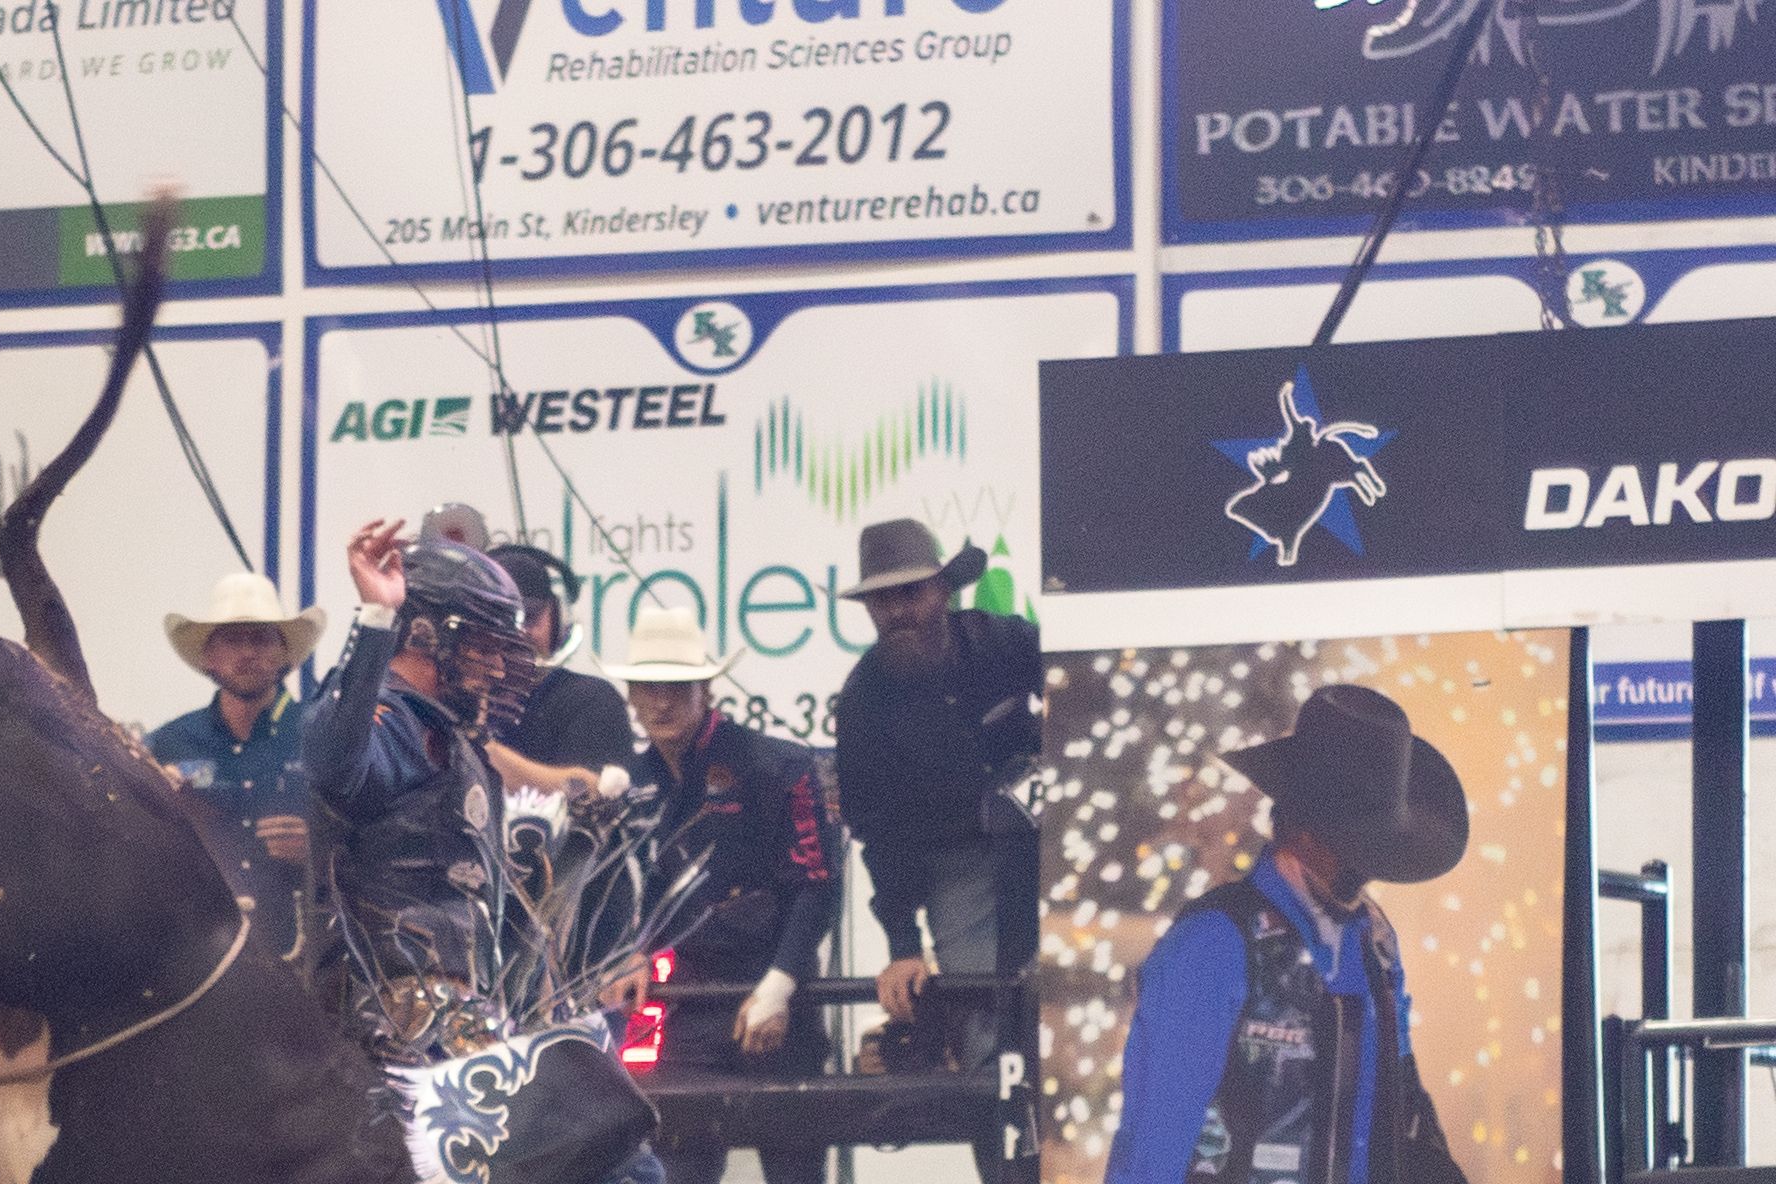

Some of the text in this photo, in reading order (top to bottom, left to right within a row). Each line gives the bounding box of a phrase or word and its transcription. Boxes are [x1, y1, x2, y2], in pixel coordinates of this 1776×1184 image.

[77, 0, 232, 31] Limited
[81, 54, 127, 78] WE
[137, 47, 232, 75] GROW
[545, 29, 1013, 83] Rehabilitation Sciences Group
[1478, 87, 1708, 140] WATER
[470, 100, 952, 184] 1-306-463-2012
[385, 217, 432, 245] 205
[441, 213, 509, 241] Main
[564, 204, 709, 239] Kindersley
[758, 184, 1042, 226] venturerehab.ca
[329, 383, 727, 443] AGI WESTEEL
[1524, 459, 1776, 531] DAKO
[589, 512, 695, 565] lights
[1617, 675, 1693, 704] futur
